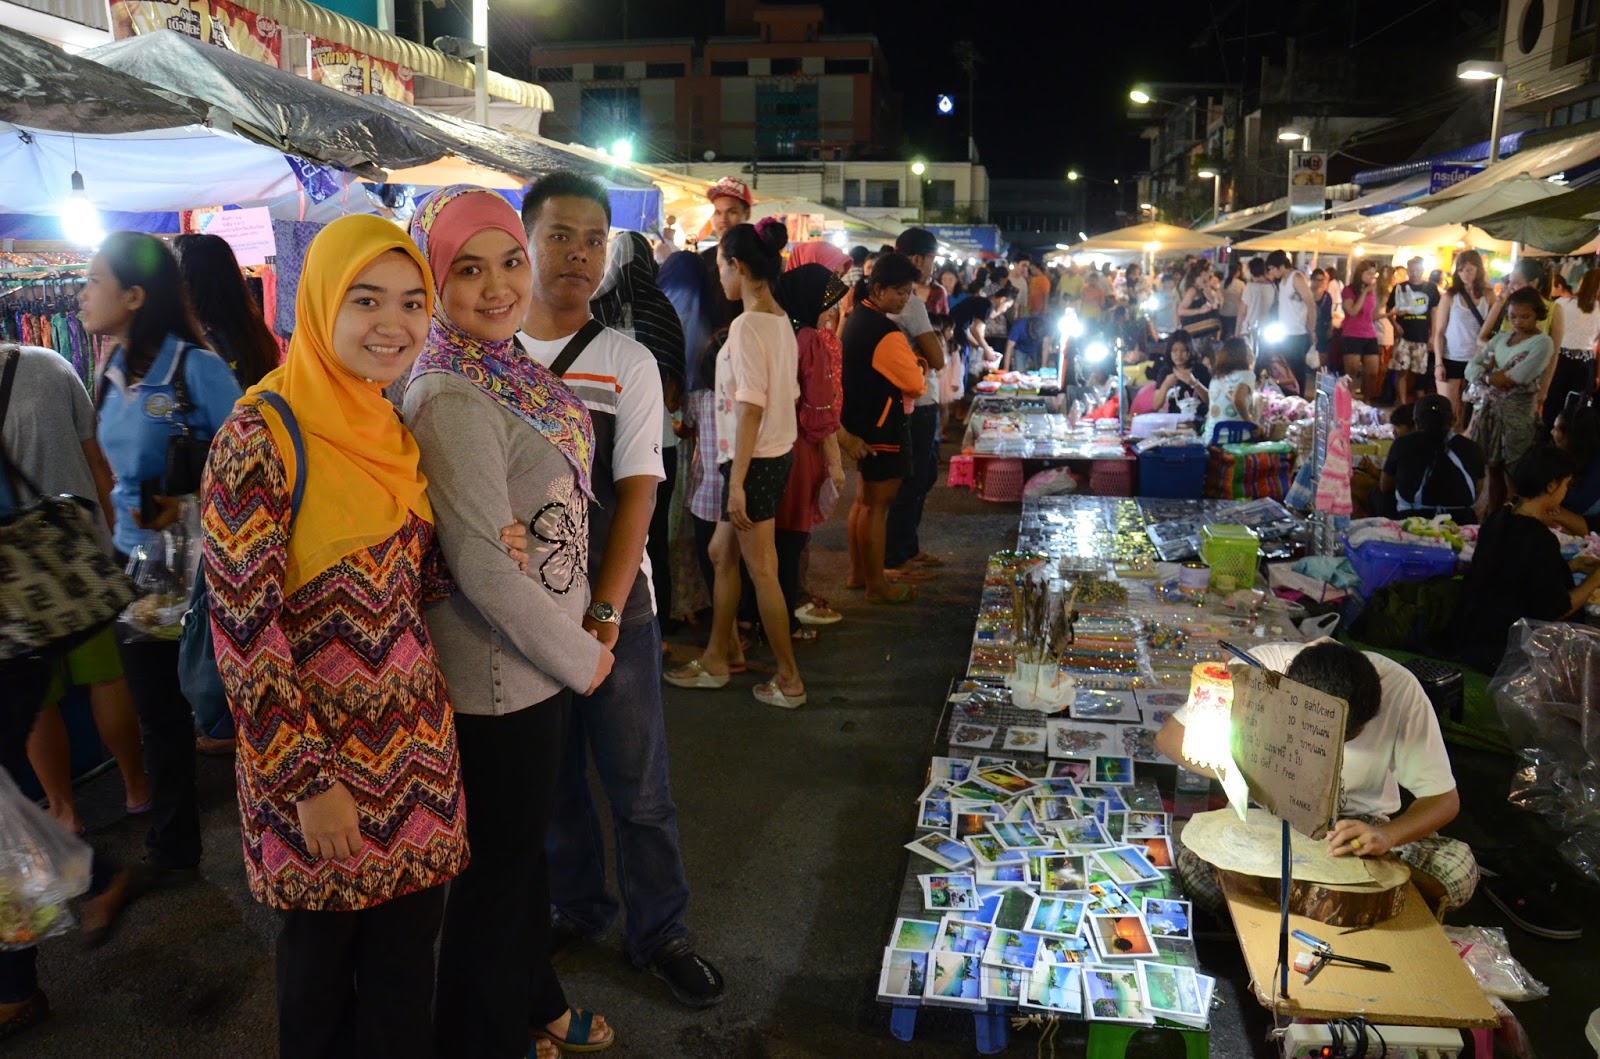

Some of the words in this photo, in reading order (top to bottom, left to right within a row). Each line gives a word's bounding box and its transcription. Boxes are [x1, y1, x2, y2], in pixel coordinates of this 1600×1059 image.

[1290, 695, 1299, 706] 10
[1287, 715, 1296, 726] 10
[1261, 756, 1272, 768] Get
[1289, 795, 1311, 812] THANKS
